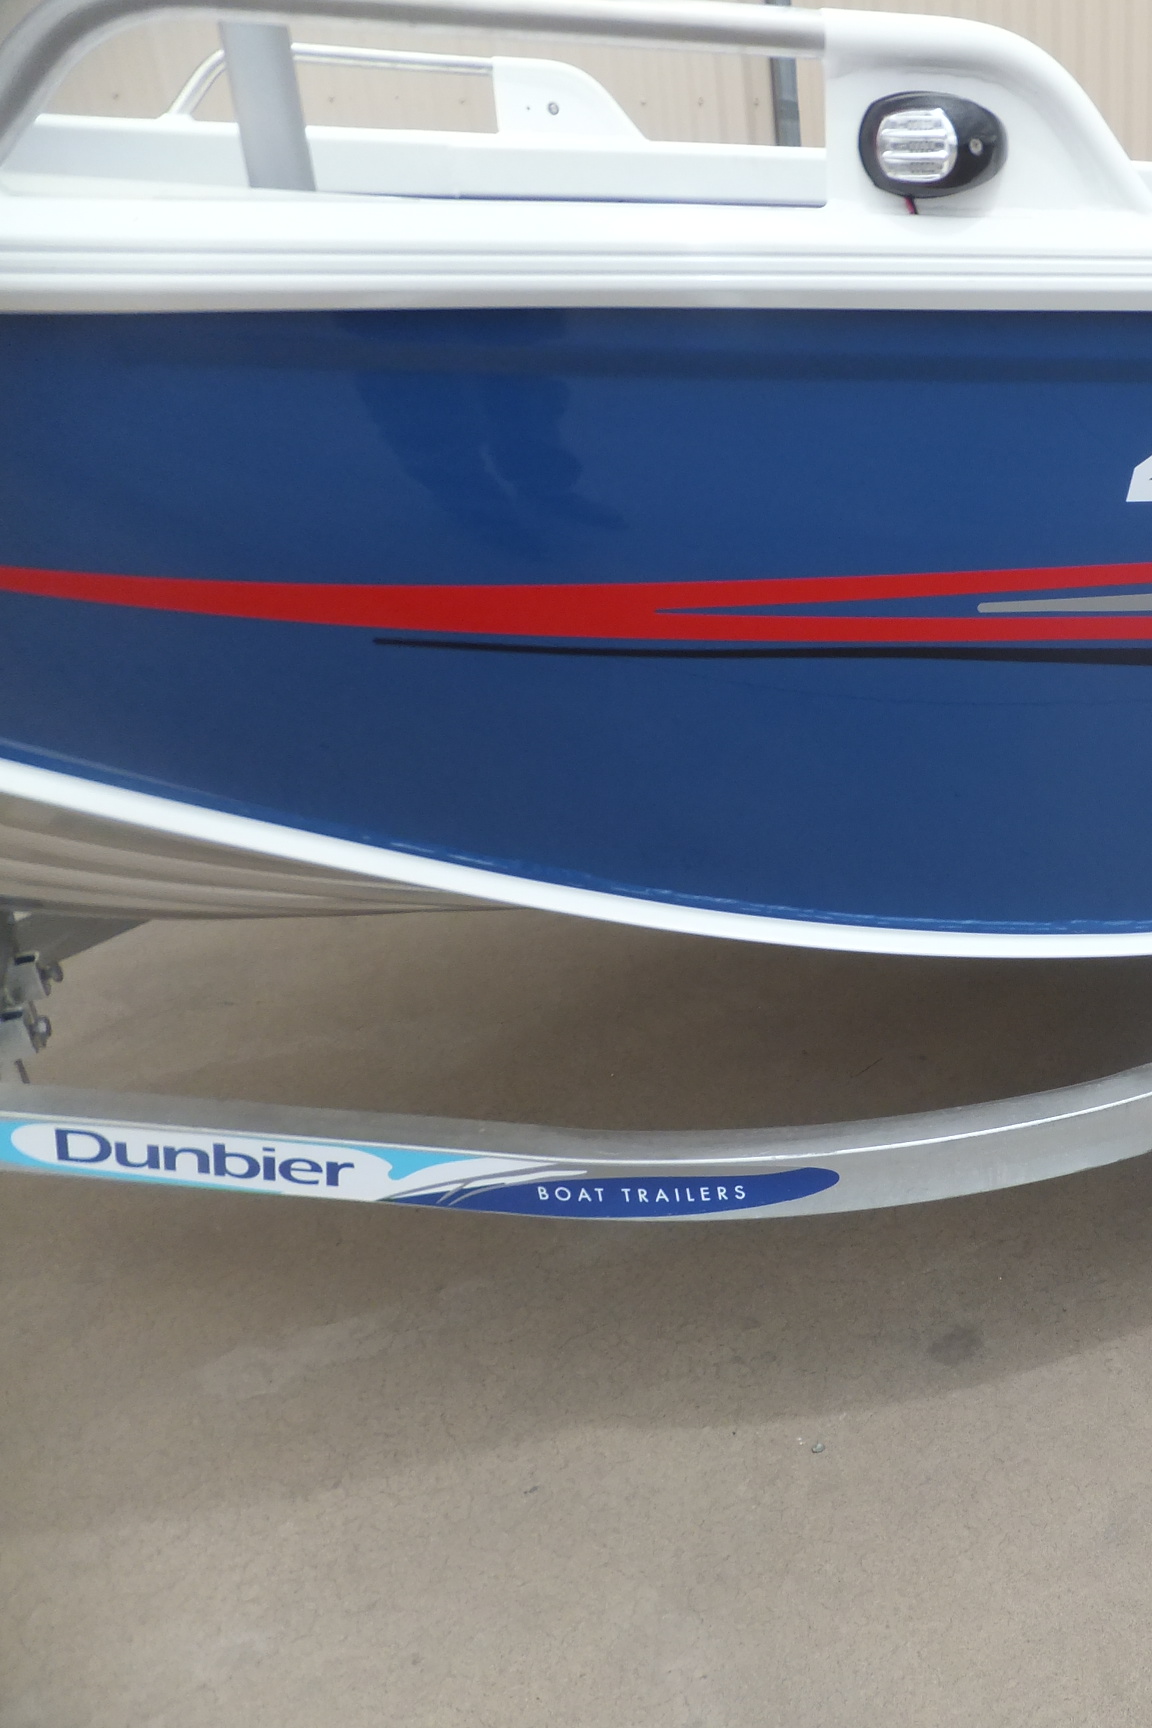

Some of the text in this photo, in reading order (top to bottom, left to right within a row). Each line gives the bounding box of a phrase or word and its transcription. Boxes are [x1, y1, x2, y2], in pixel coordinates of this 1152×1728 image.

[54, 1128, 355, 1187] Dunbier
[537, 1185, 746, 1203] BOAT TRAILERS
